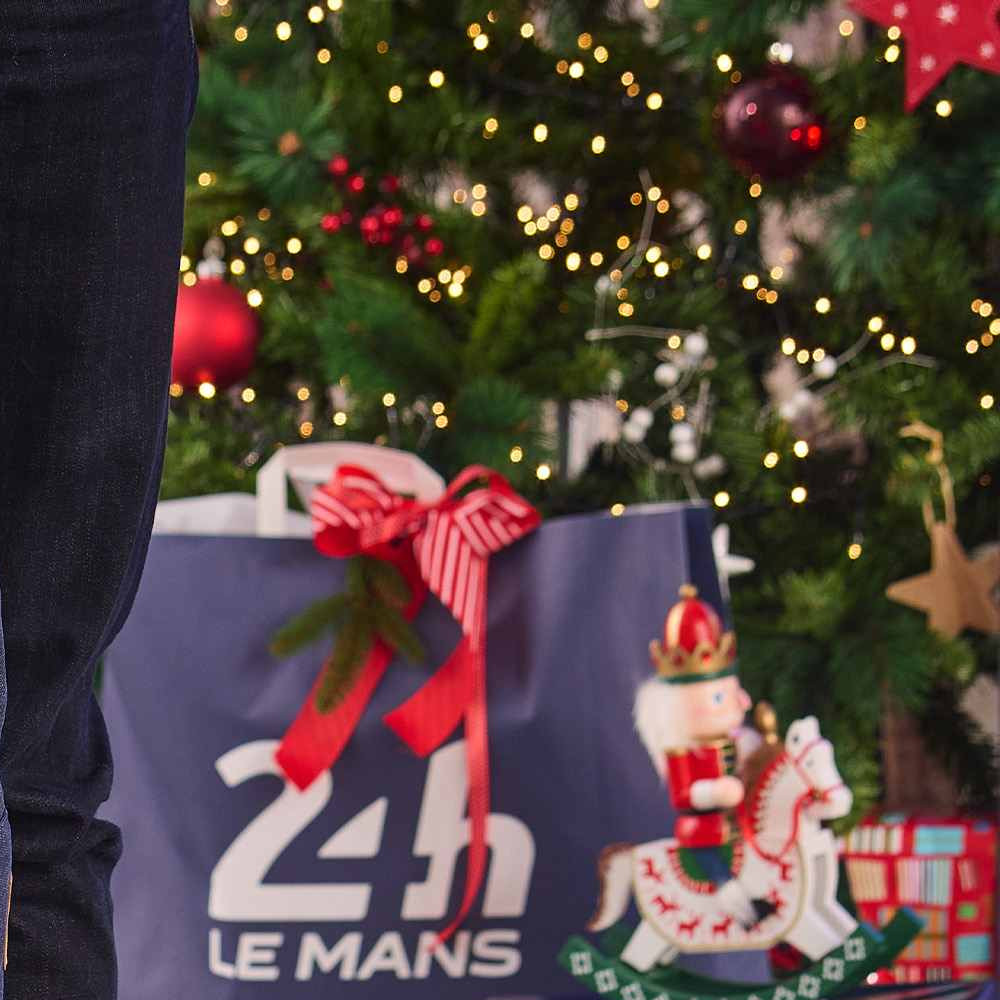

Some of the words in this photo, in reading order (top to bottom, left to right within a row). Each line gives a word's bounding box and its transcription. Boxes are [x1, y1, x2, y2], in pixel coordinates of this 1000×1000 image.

[208, 739, 536, 922] 24h
[208, 928, 284, 981] LE
[295, 929, 522, 981] MANS
